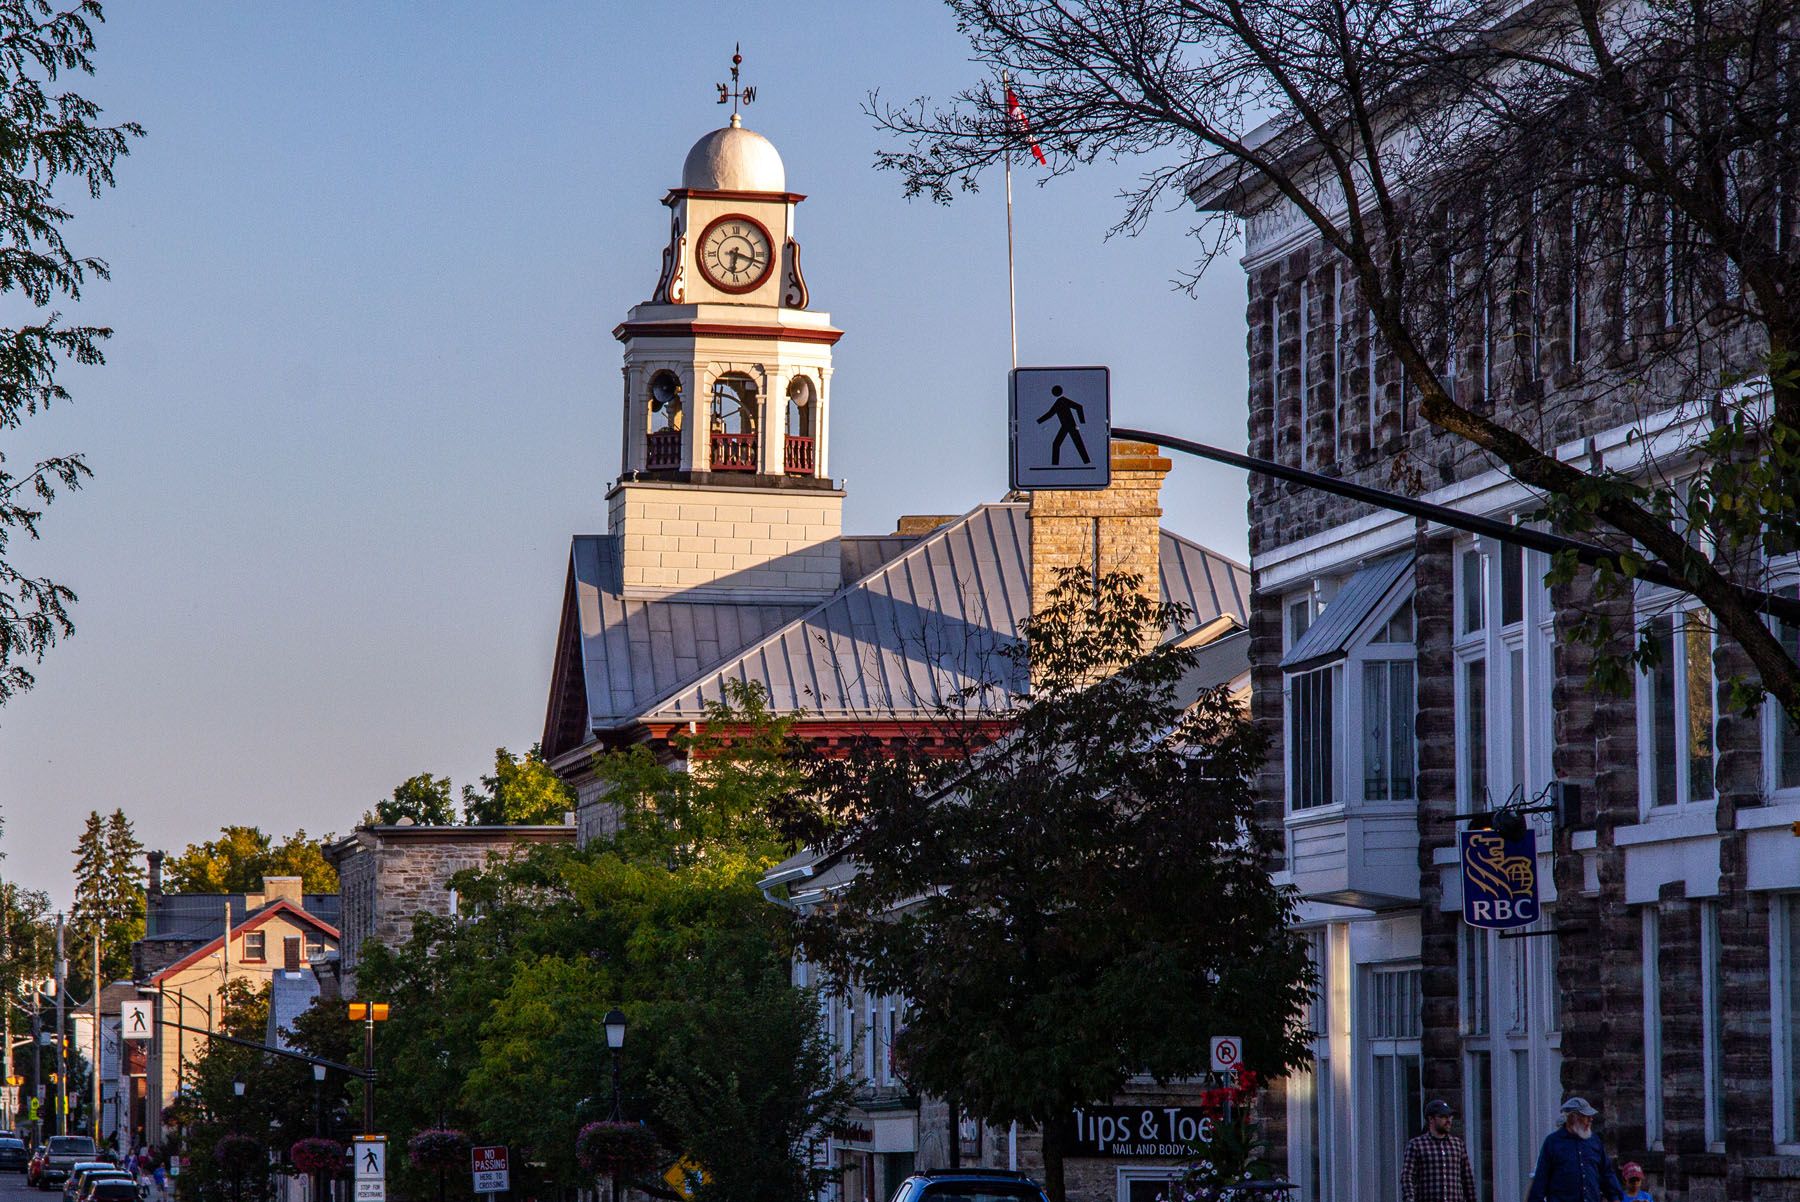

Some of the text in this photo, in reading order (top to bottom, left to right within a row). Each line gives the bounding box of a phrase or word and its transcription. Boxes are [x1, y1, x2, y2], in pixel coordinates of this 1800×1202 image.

[1472, 898, 1533, 921] RBC
[1072, 1107, 1215, 1151] Tips & Toe
[484, 1149, 495, 1160] NO
[1112, 1143, 1135, 1155] NAIL
[1135, 1143, 1157, 1155] AND
[1159, 1143, 1186, 1155] BODY
[475, 1159, 506, 1171] PASSING
[480, 1172, 503, 1181] HERE TO
[479, 1180, 504, 1189] CROSSING
